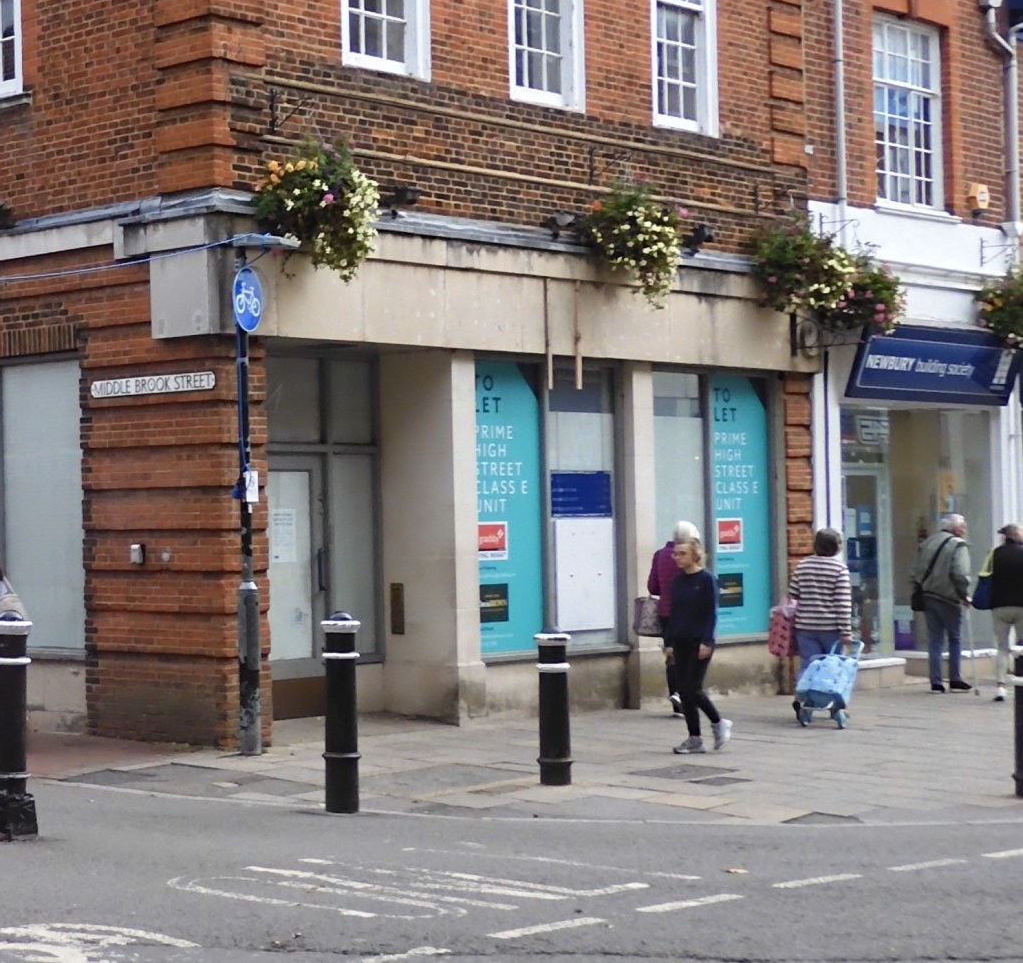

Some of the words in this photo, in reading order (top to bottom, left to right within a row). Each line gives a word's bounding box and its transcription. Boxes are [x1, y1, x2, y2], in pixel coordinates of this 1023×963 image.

[865, 354, 916, 372] NEWBURY
[915, 358, 948, 378] building
[947, 363, 976, 379] society
[94, 379, 131, 396] MIDDLE
[135, 377, 171, 393] BROOK
[174, 373, 212, 389] STREET
[713, 387, 731, 403] TO
[713, 407, 737, 422] LET
[714, 432, 747, 446] PRIME
[715, 448, 742, 462] HIGH
[715, 465, 754, 478] STREET
[521, 480, 529, 494] E
[716, 481, 750, 494] CLASS
[752, 481, 760, 494] E
[717, 497, 743, 511] UNIT
